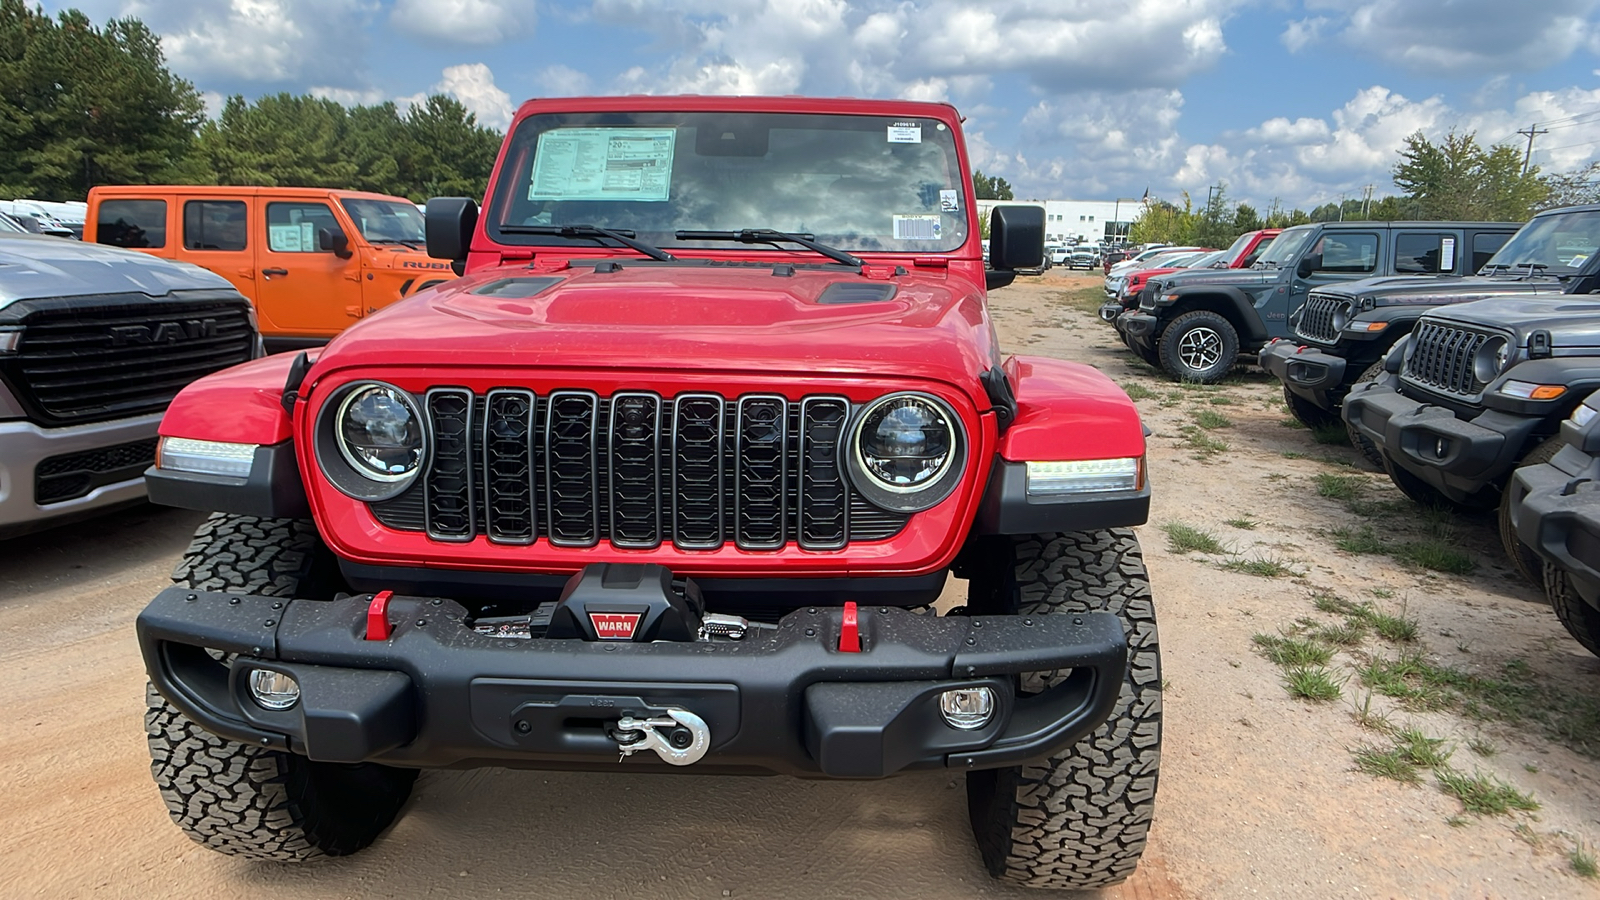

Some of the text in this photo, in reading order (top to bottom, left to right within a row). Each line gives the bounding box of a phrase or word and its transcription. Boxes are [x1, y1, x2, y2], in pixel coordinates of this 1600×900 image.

[403, 261, 450, 269] RUBI
[109, 319, 217, 345] RAM
[598, 621, 632, 632] WARN
